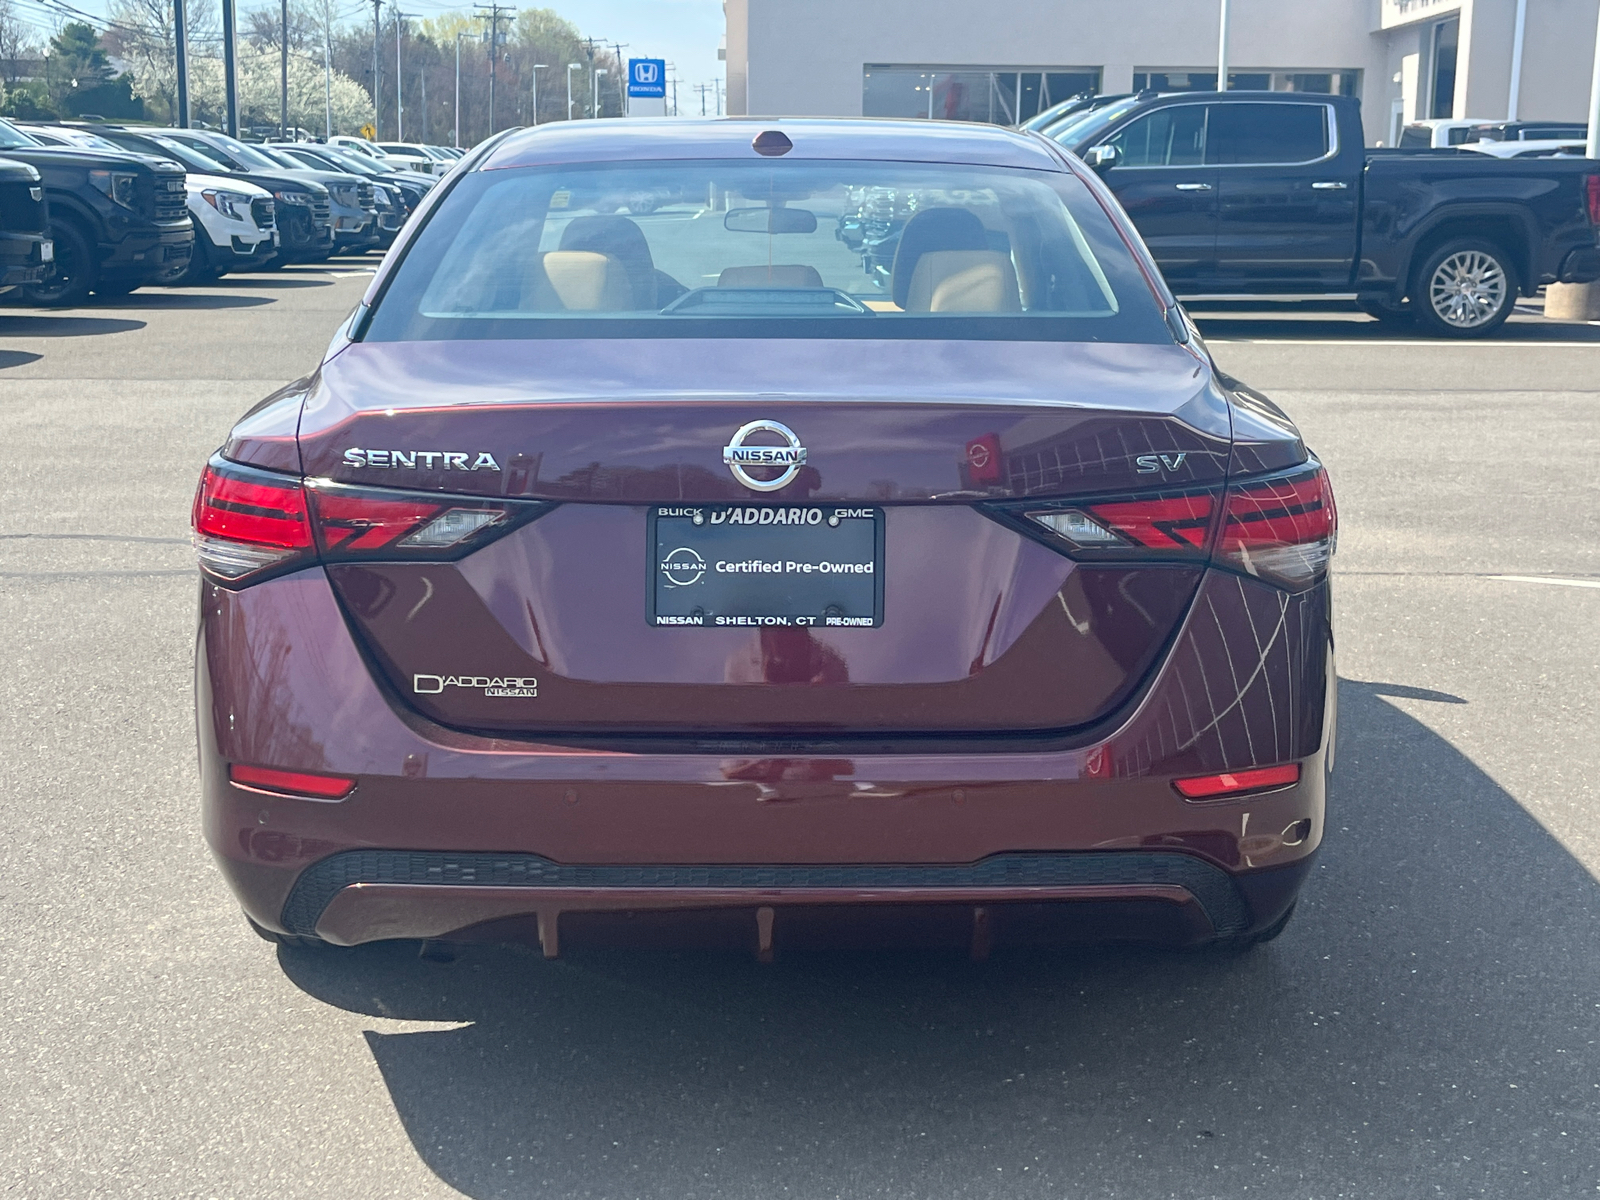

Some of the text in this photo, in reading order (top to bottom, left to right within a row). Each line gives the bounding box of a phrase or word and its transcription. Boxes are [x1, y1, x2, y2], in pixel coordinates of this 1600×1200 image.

[342, 448, 501, 471] SENTRA
[732, 450, 798, 462] NISSAN
[1136, 452, 1187, 474] SV
[658, 507, 703, 517] BUICK
[710, 507, 823, 525] D'ADDARIO
[834, 508, 874, 518] GMC
[715, 560, 874, 574] Certified Pre-Owned
[656, 616, 703, 625] NISSAN
[715, 616, 817, 627] SHELTON, CT
[825, 617, 873, 626] PRE-OWNED
[413, 673, 538, 694] D'ADDARIO
[486, 688, 536, 696] NISSAN
